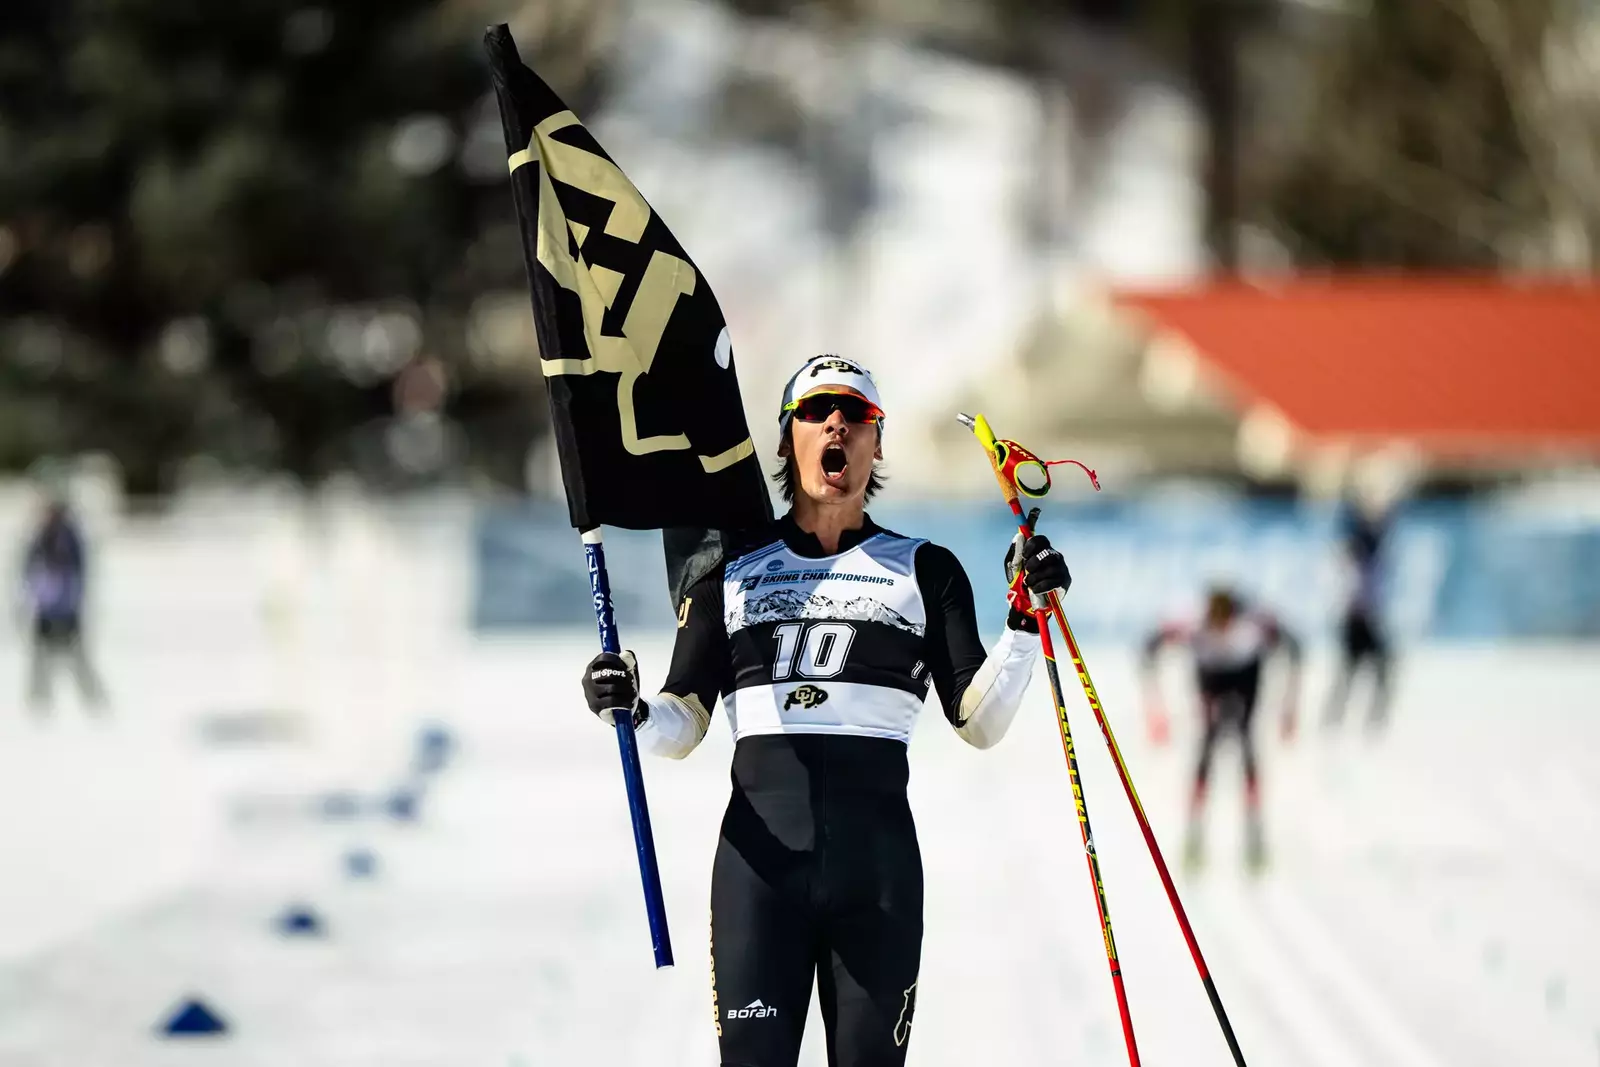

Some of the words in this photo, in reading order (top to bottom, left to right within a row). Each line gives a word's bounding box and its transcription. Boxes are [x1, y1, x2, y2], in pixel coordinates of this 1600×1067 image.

[761, 573, 799, 584] SKIING
[801, 572, 895, 587] CHAMPIONSHIPS
[772, 622, 857, 681] 10
[795, 687, 817, 705] CU
